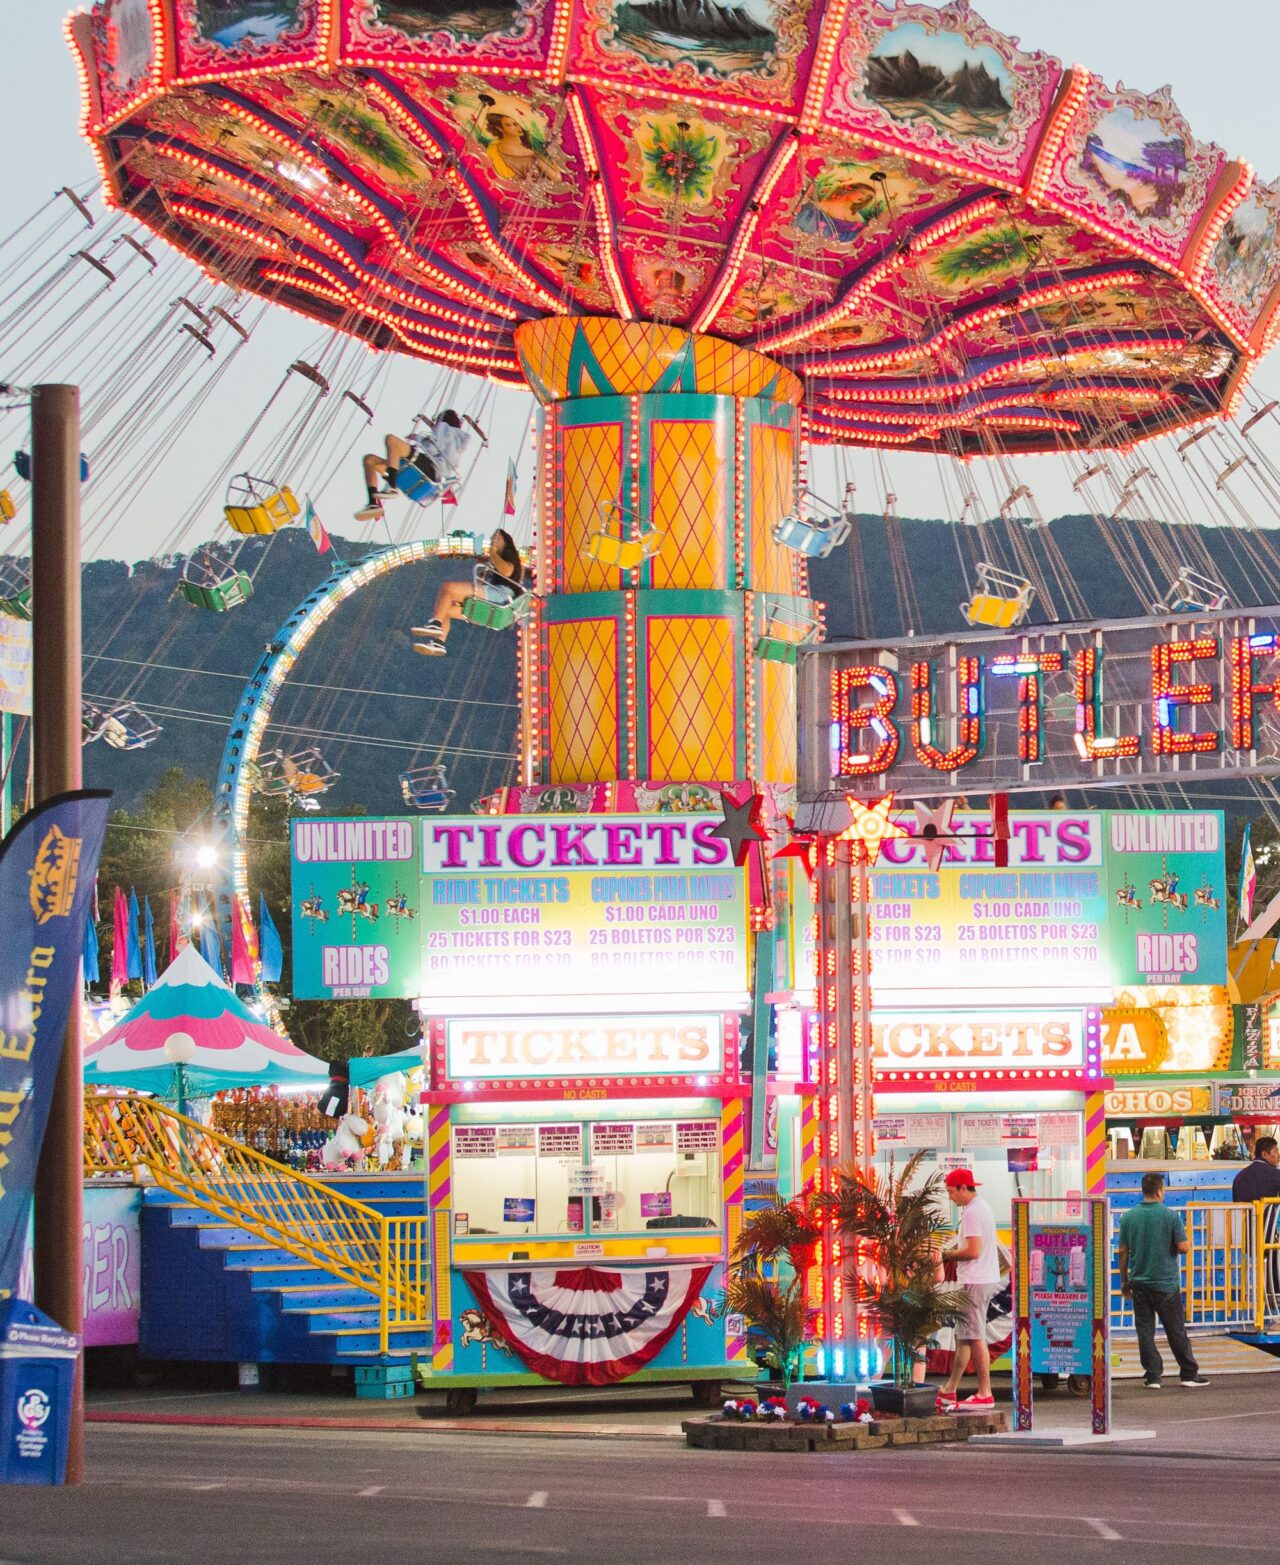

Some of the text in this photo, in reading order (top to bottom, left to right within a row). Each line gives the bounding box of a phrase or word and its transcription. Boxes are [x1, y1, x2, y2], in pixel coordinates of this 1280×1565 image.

[295, 822, 414, 862] UNLIMITED
[1111, 814, 1220, 853] UNLIMITED
[433, 819, 729, 868] TICKETS
[432, 877, 570, 904] RIDE TICKETS
[591, 877, 652, 903] CUPONES
[959, 874, 1018, 899] CUPONES
[460, 908, 541, 925] $1.00 EACH
[606, 904, 718, 922] $1.00 CADA UNO
[876, 904, 911, 919] EACH
[973, 902, 1082, 919] $1.00 CADA UNO
[429, 930, 572, 949] 25 TICKETS FOR $23
[590, 927, 735, 946] 25 BOLETOS POR $23
[885, 925, 942, 942] FOR $23
[958, 924, 1097, 941] 25 BOLETOS POR $23
[430, 952, 572, 971] 80 TICKETS FOR $70
[590, 949, 735, 967] 80 BOLETOS POR $70
[885, 947, 941, 964] FOR $70
[958, 946, 1097, 964] 80 BOLETOS POR $70
[1136, 933, 1199, 974] RIDES
[322, 945, 390, 986] RIDES
[1146, 974, 1182, 984] PER DAY
[333, 987, 352, 997] PER
[0, 946, 55, 1061] Extra
[461, 1026, 710, 1065] TICKETS
[1245, 1006, 1260, 1068] PIZZA
[563, 1089, 607, 1100] NO CASTS
[934, 1081, 977, 1092] NO CASTS
[1238, 1087, 1255, 1096] ICE
[964, 1119, 976, 1128] RIDE
[977, 1119, 998, 1128] TICKETS
[1034, 1233, 1088, 1248] BUTLER
[1034, 1292, 1053, 1300] PLEASE
[1080, 1293, 1088, 1301] UP
